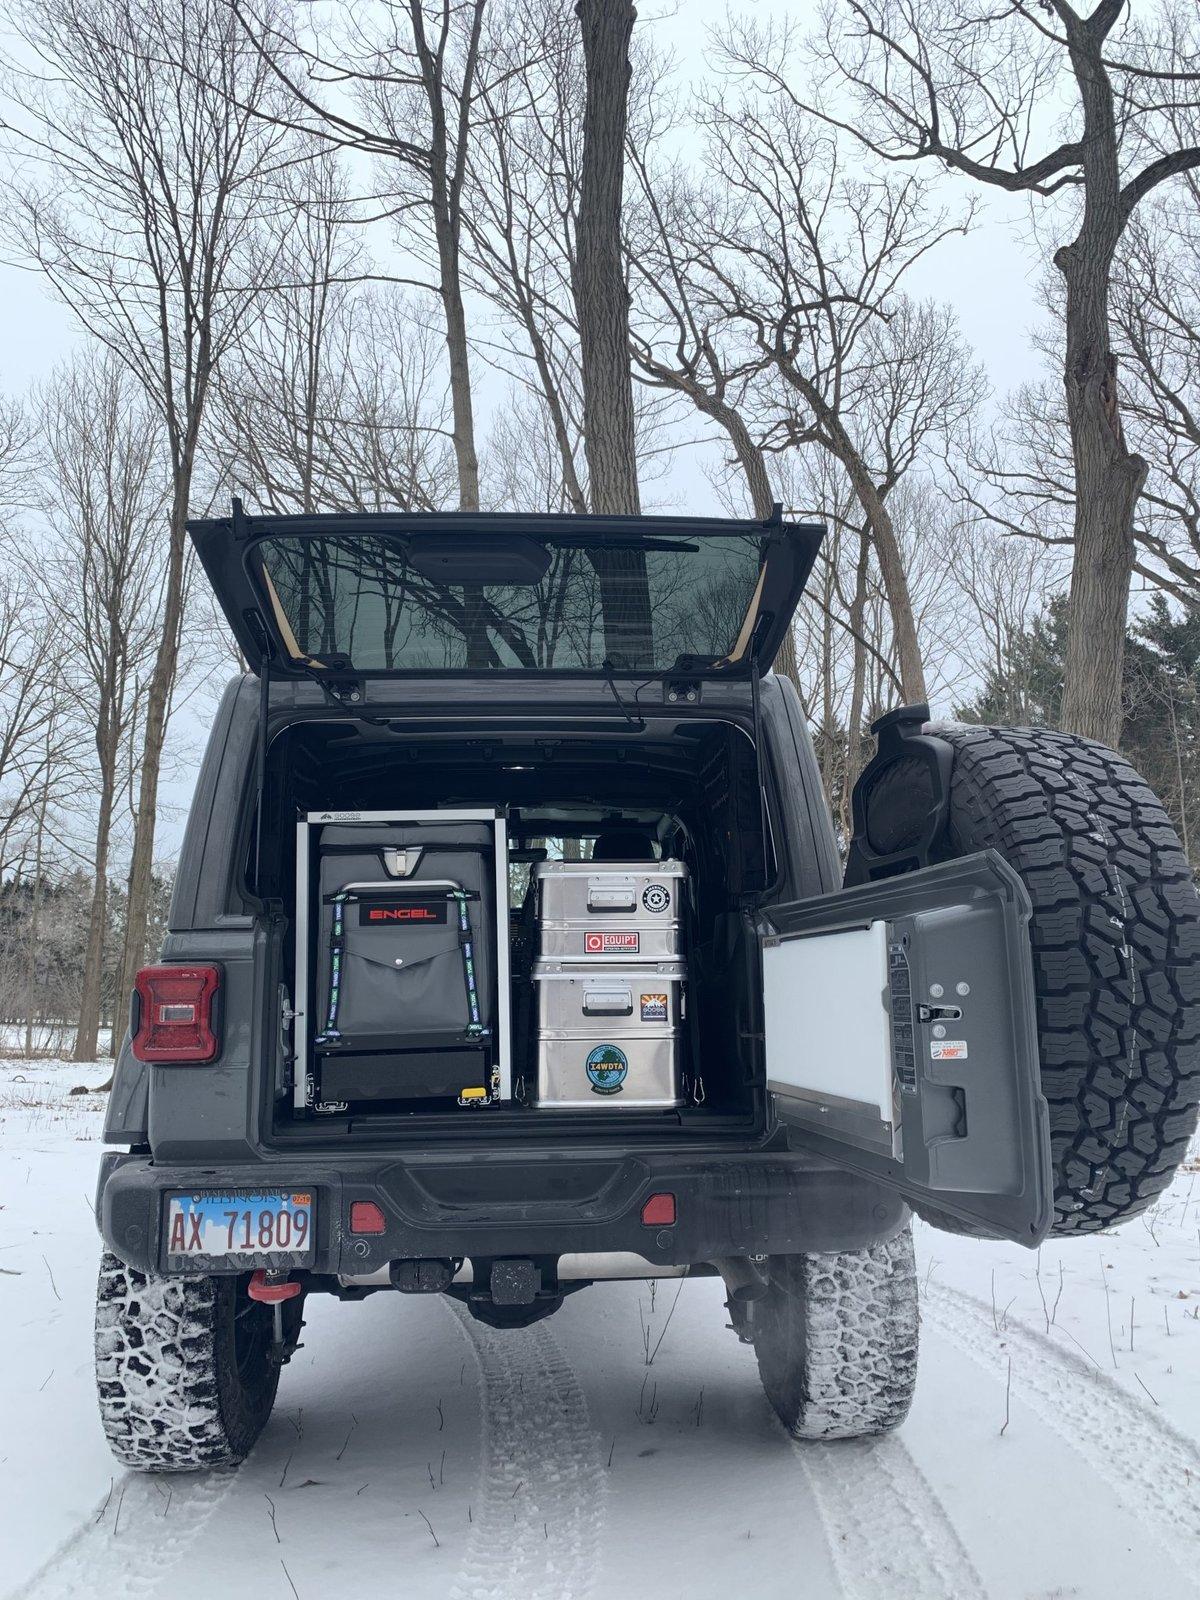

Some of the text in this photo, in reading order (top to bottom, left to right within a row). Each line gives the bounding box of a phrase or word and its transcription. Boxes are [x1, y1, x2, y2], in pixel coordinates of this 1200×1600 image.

[369, 908, 437, 920] ENGEL
[604, 935, 636, 945] EQUIPT
[590, 1063, 624, 1071] I4WDTA
[170, 1209, 309, 1251] AX 71809
[167, 1251, 309, 1271] U.S. NAVY
